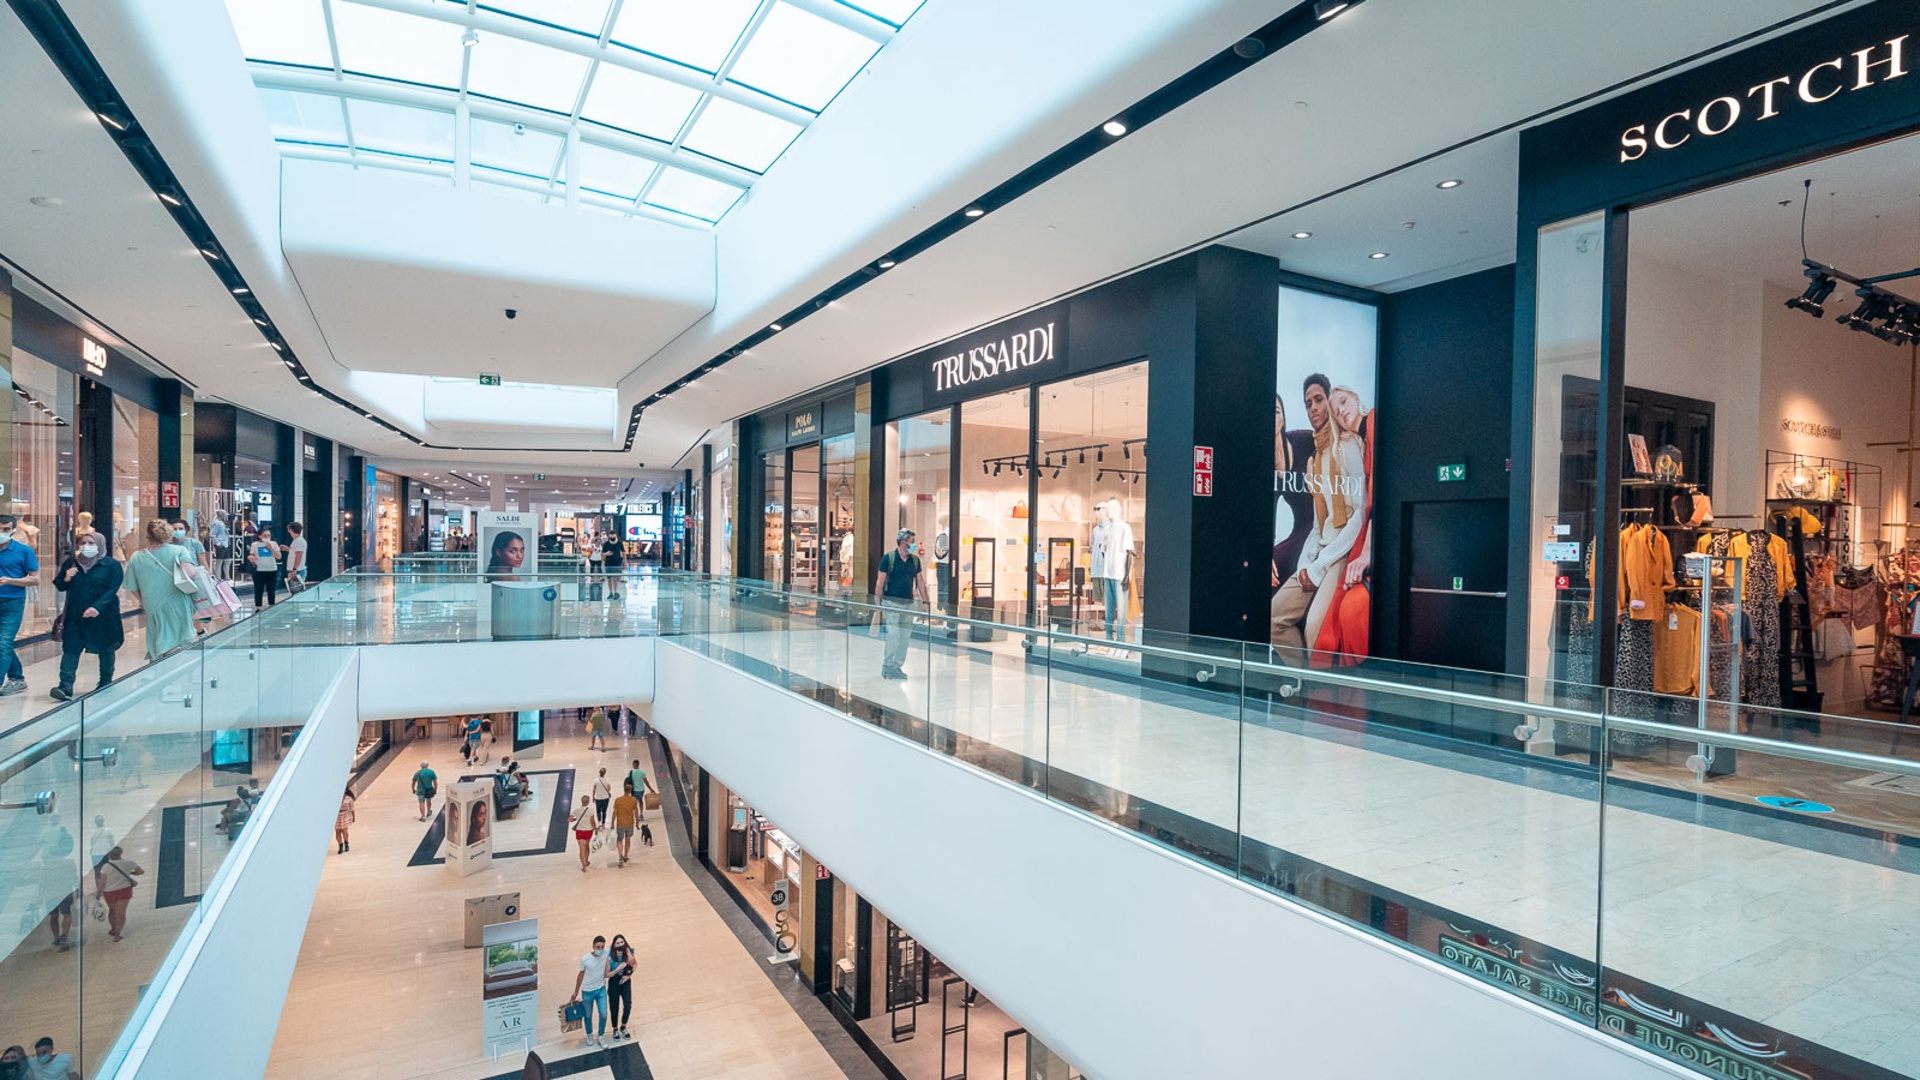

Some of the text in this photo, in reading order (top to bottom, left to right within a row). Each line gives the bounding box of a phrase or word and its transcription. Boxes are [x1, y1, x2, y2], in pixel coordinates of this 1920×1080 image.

[1620, 34, 1910, 164] SCOTCH
[931, 322, 1055, 392] TRUSSARDI
[795, 412, 812, 428] POLO
[1273, 470, 1364, 496] TRUSSARDI
[772, 892, 784, 903] 38
